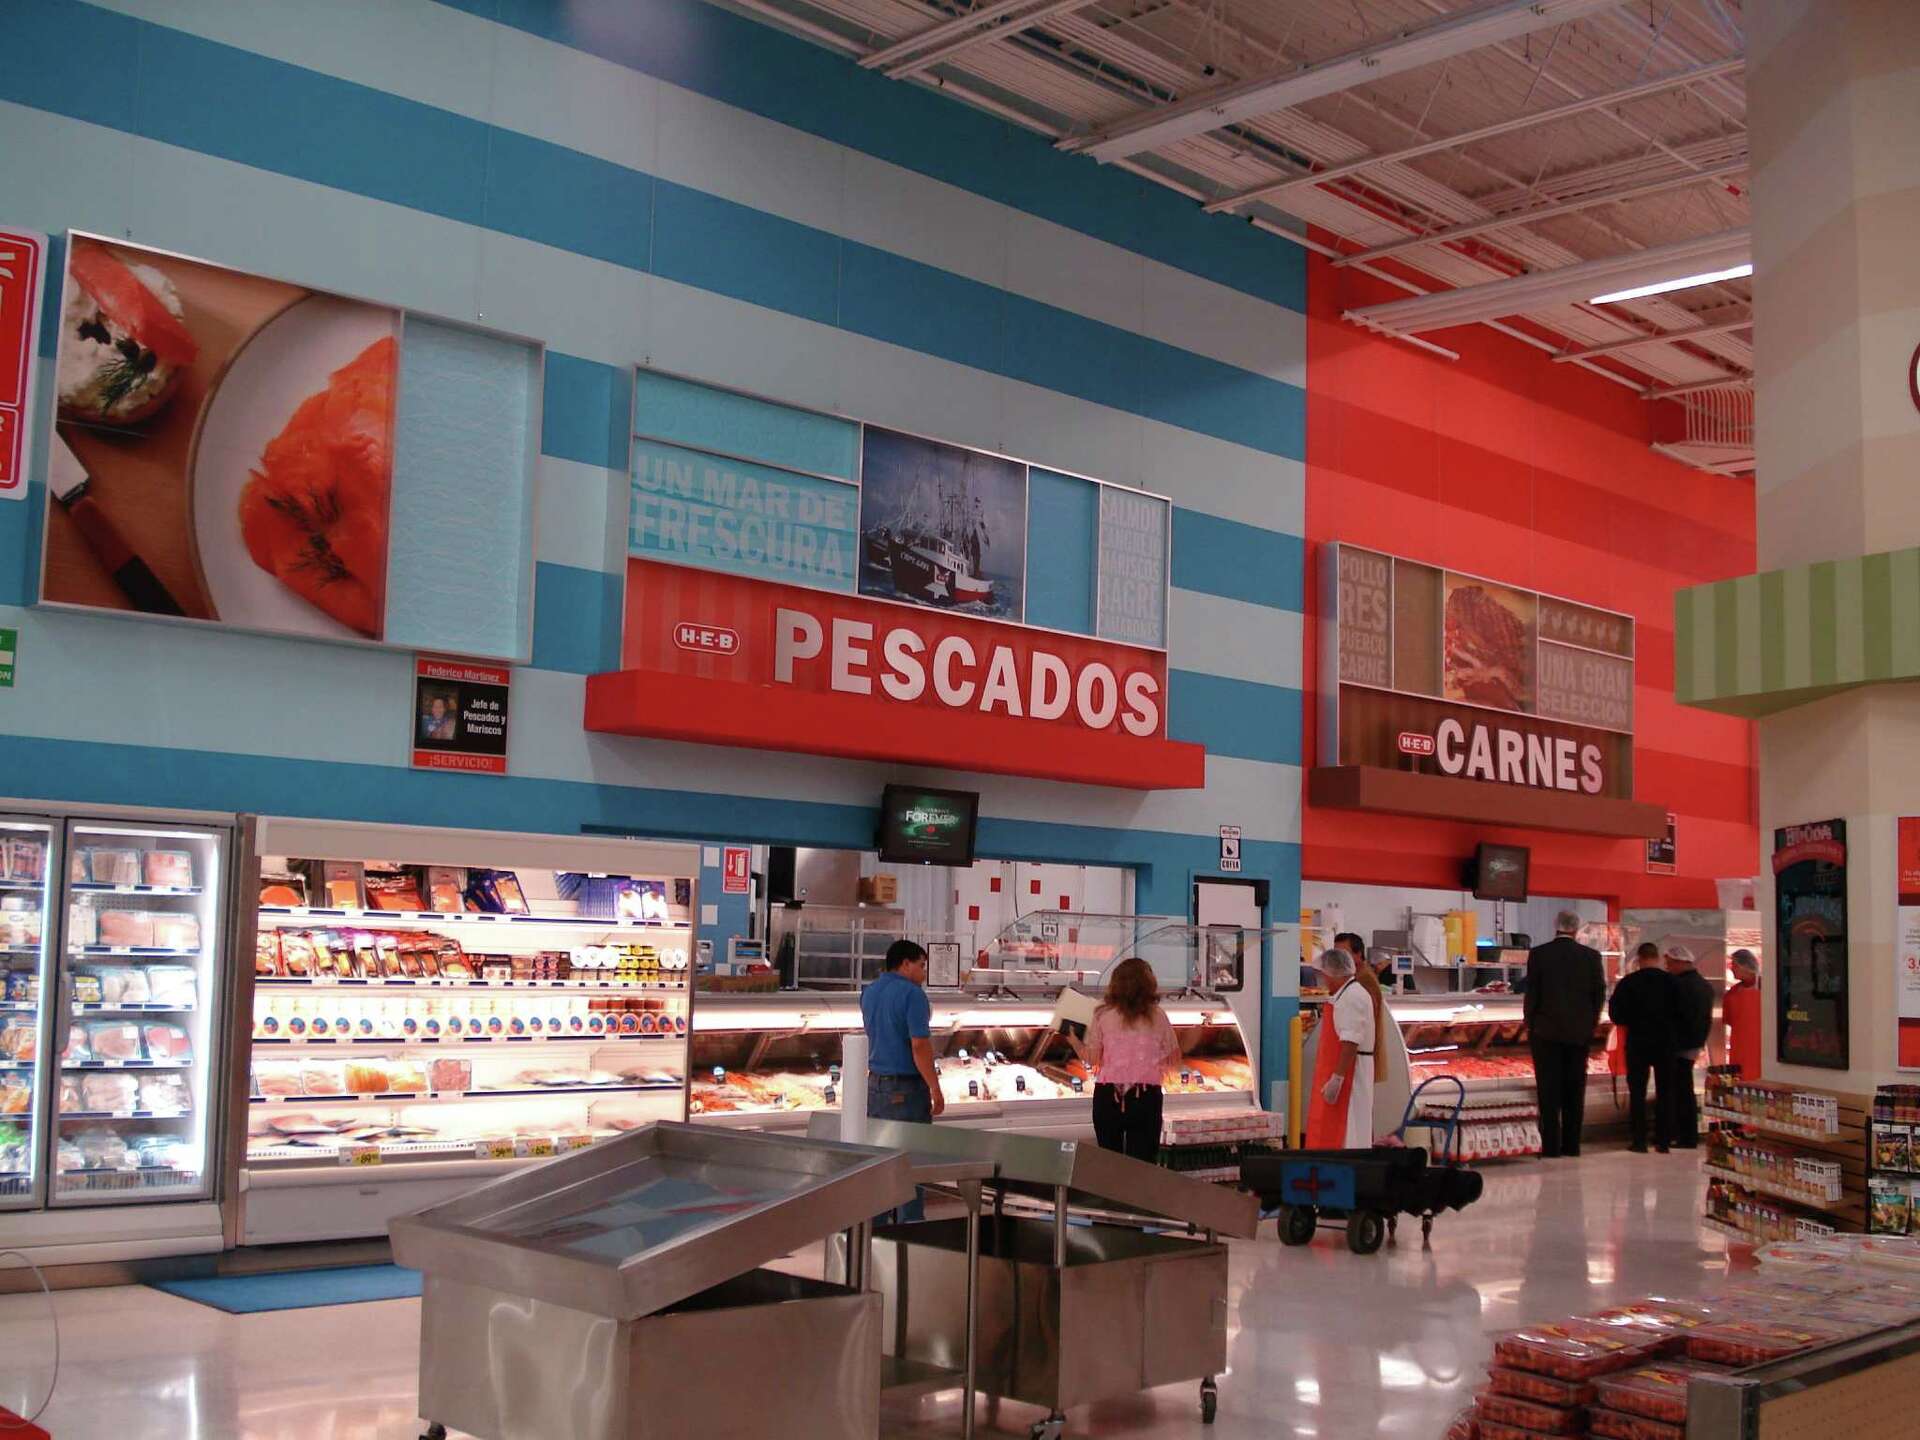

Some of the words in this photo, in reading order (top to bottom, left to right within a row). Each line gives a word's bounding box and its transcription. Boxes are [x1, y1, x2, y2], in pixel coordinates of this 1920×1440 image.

[637, 455, 694, 497] UN
[703, 468, 790, 519] MAR
[800, 491, 846, 530] DE
[634, 493, 843, 581] FRESCURA
[1340, 553, 1386, 588] POLLO
[1340, 582, 1387, 632] RES
[1340, 628, 1386, 656] PUERCO
[427, 664, 462, 678] Federico
[774, 607, 1160, 737] PESCADOS
[1340, 652, 1386, 682] CARNE
[1540, 651, 1576, 691] UNA
[1582, 660, 1628, 701] GRAN
[463, 710, 500, 723] Pescados
[501, 716, 506, 725] y
[471, 699, 487, 710] Jefe
[489, 700, 499, 710] de
[467, 723, 502, 735] Mariscos
[1437, 718, 1603, 794] CARNES
